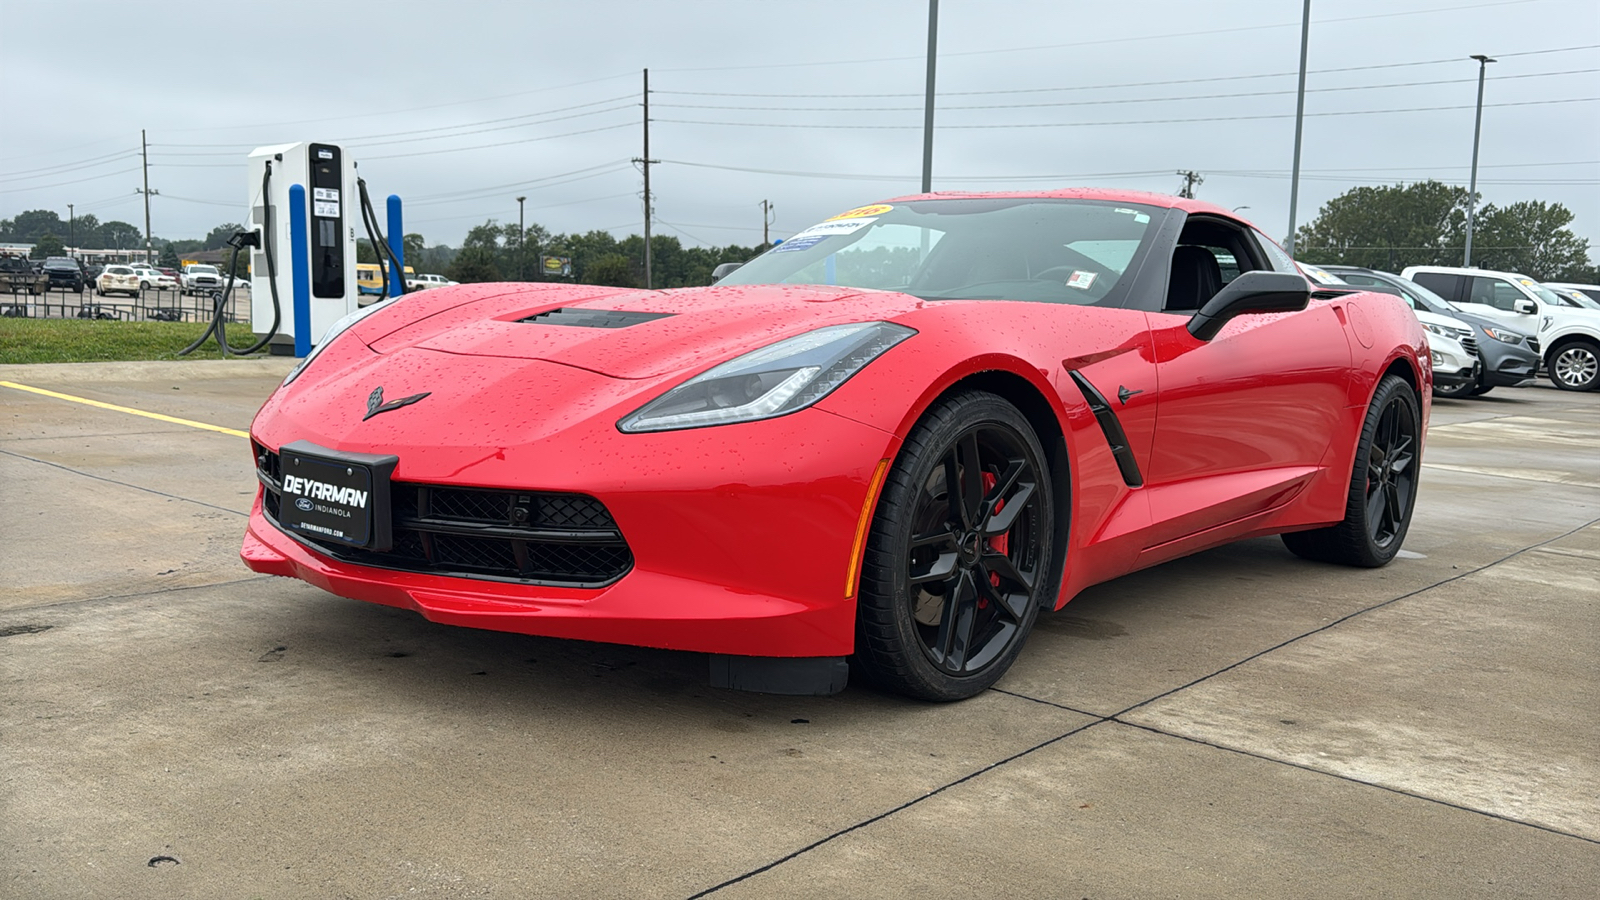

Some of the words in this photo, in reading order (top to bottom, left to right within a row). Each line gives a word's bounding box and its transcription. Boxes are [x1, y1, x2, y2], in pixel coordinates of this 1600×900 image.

[283, 474, 368, 509] DEYARMAN
[297, 499, 312, 510] Ford
[315, 504, 351, 518] INDIANOLA
[300, 521, 344, 538] DEYARMANFORD.COM
